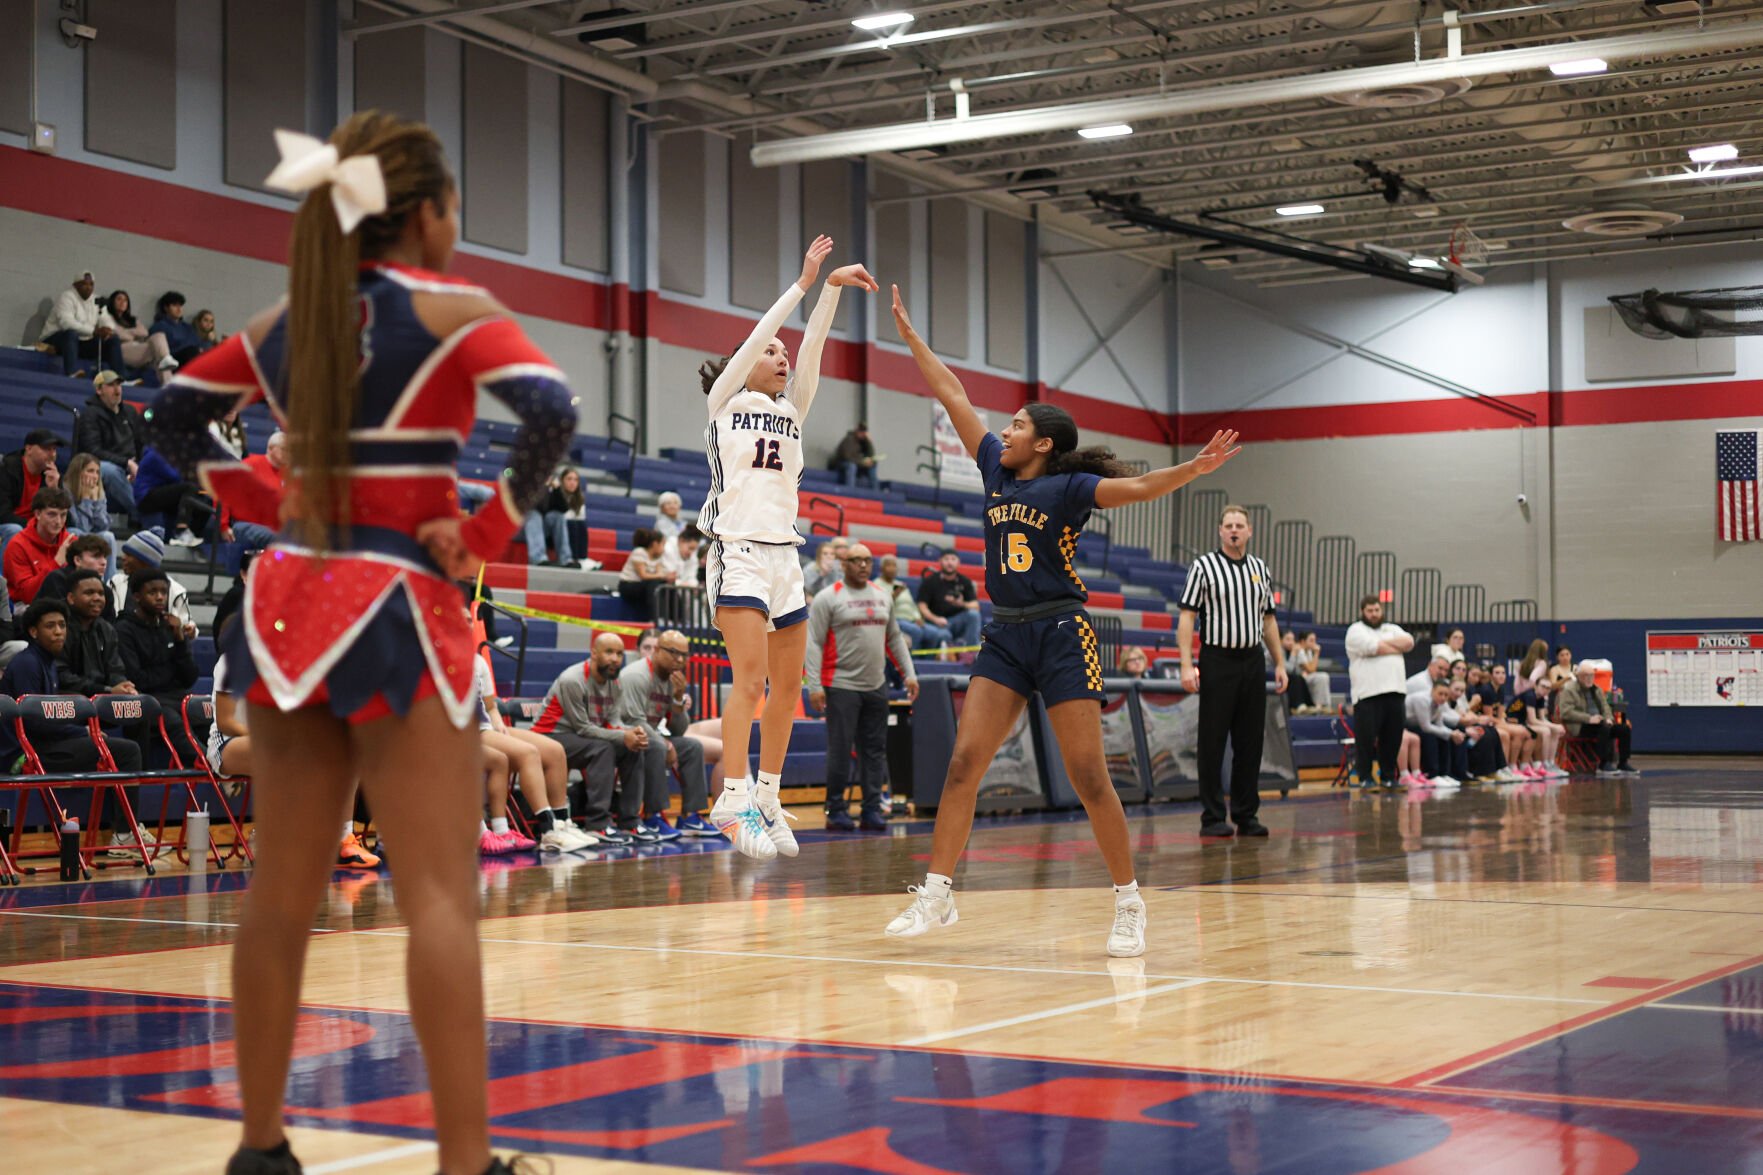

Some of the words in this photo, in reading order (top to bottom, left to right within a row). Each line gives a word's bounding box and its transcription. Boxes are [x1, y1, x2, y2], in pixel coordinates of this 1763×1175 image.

[731, 412, 800, 440] PATRIOTS
[752, 437, 783, 472] 12
[987, 505, 1009, 527] THE
[1010, 502, 1049, 531] VILLE
[1697, 636, 1750, 649] PATRIOTS
[40, 700, 76, 719] WHS
[111, 700, 143, 718] WHS
